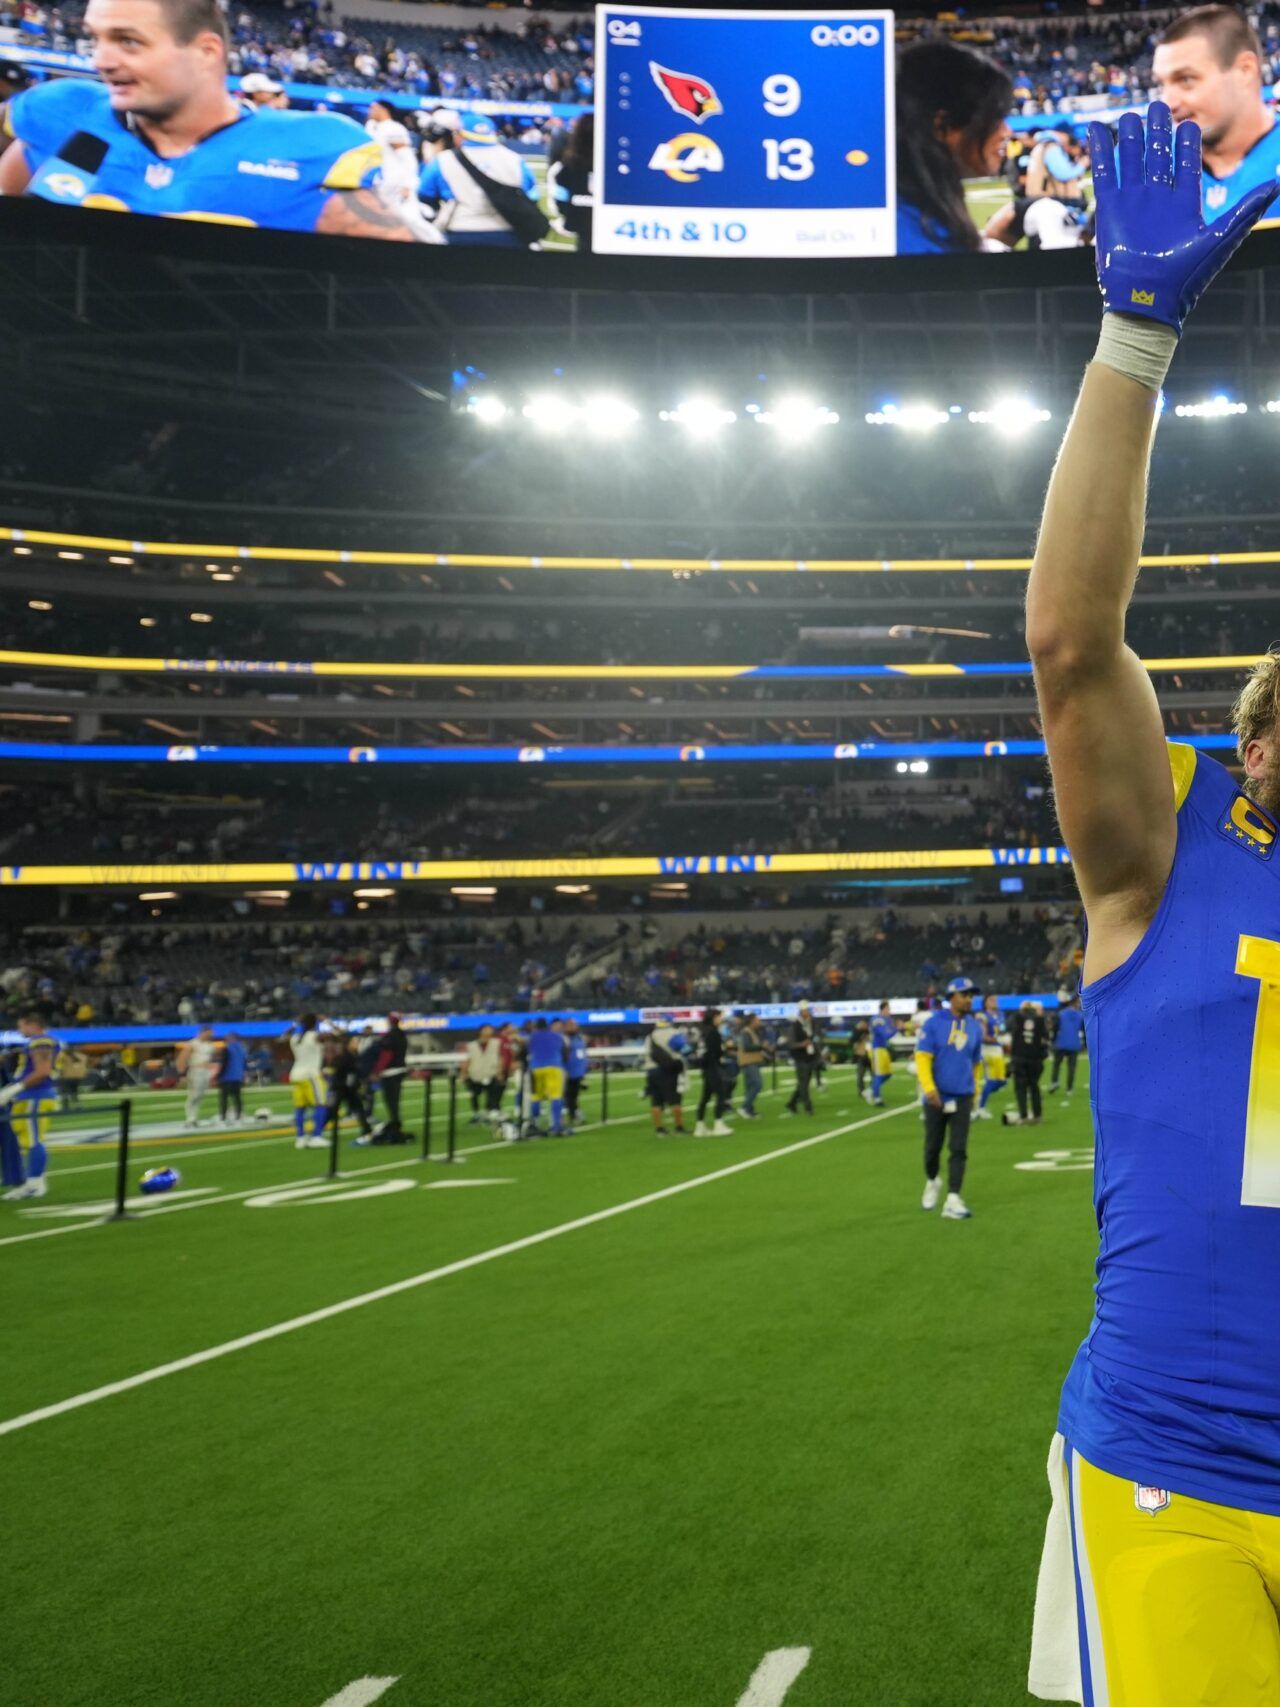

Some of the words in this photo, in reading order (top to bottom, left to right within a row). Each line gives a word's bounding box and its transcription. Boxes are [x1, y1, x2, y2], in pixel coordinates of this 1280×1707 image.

[810, 25, 880, 46] 0:00
[762, 74, 801, 117] 9
[762, 138, 815, 181] 13
[614, 221, 670, 240] 4th
[681, 221, 700, 241] &
[711, 222, 747, 242] 10
[1230, 796, 1276, 845] C
